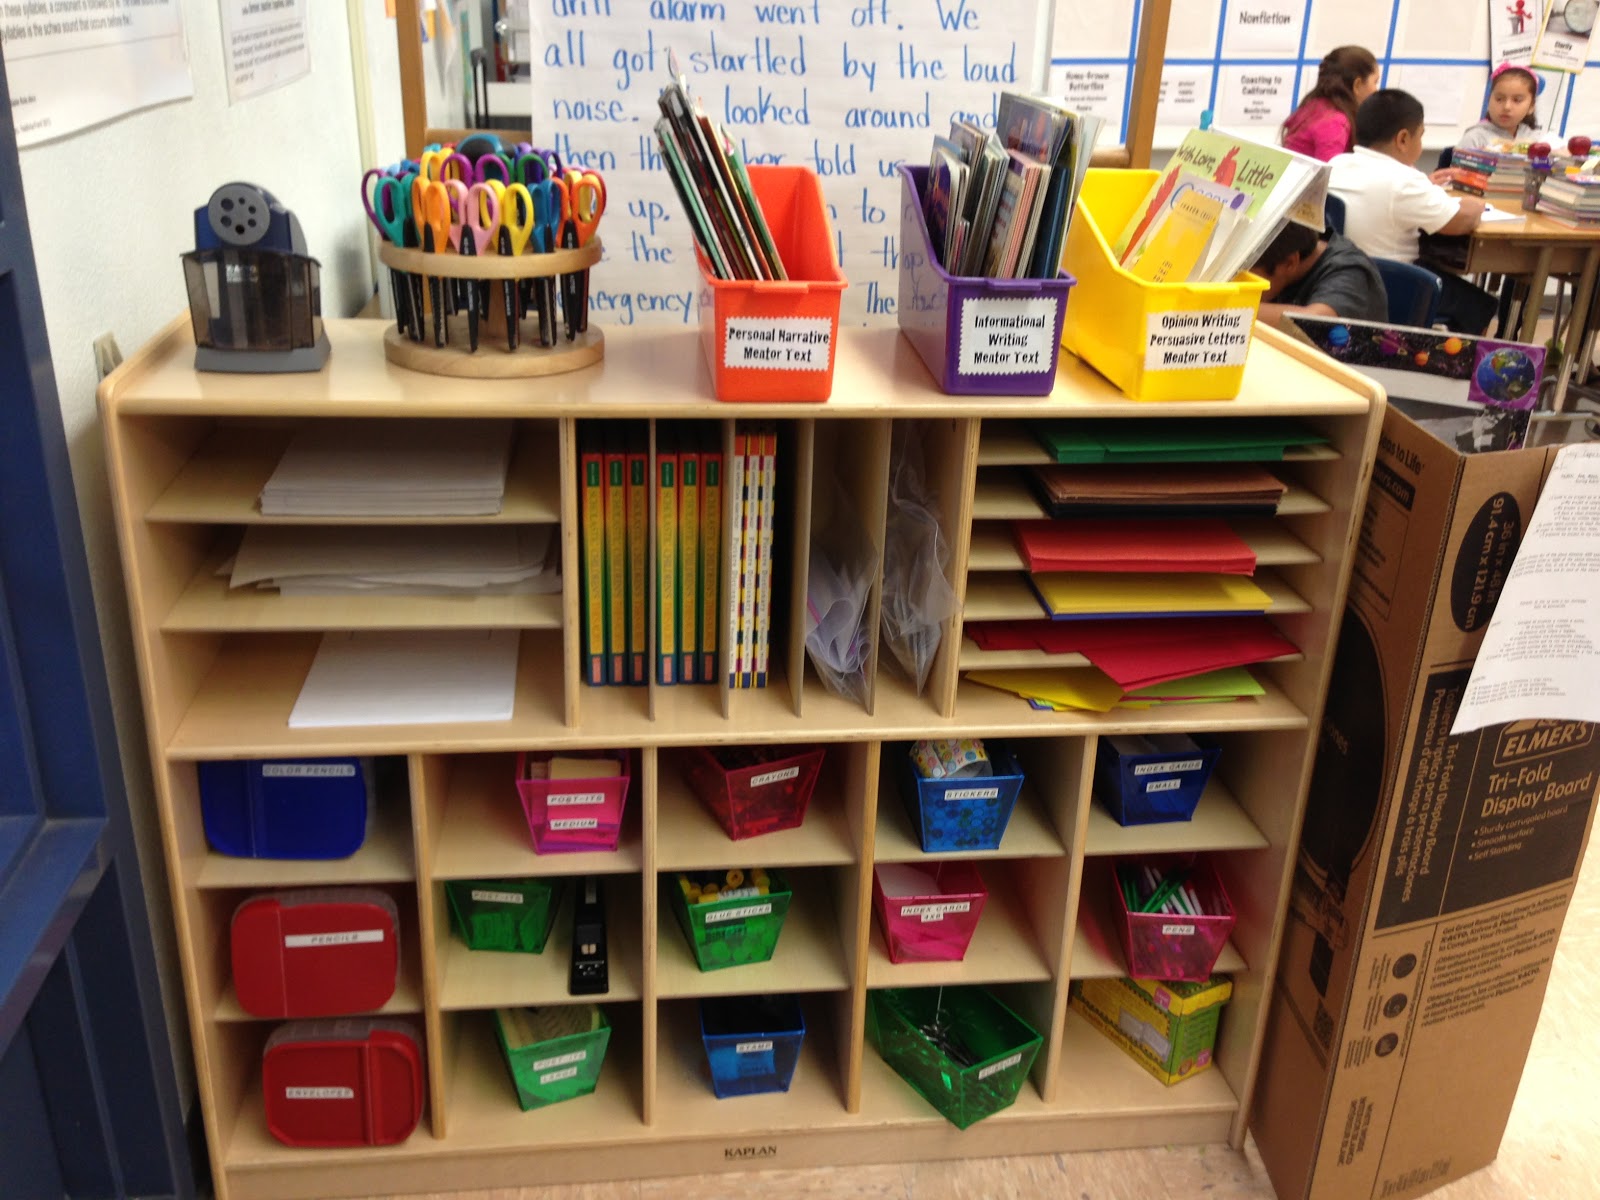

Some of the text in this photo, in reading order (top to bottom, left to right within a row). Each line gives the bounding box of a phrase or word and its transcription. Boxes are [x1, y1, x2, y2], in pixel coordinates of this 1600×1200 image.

[650, 0, 725, 22] alarm
[755, 0, 820, 24] went
[936, 0, 980, 31] We
[1239, 11, 1291, 24] Nonfiction
[544, 29, 1017, 92] all got startled by the loud
[1242, 86, 1278, 95] California
[1274, 76, 1282, 85] to
[553, 97, 639, 122] noise.
[724, 84, 810, 126] looked
[844, 91, 931, 129] around
[1236, 157, 1275, 190] Little
[627, 187, 886, 236] up. to
[625, 230, 677, 265] the
[588, 290, 693, 326] ergency
[974, 315, 1046, 328] Informational
[1162, 313, 1242, 330] Opinion Writing
[728, 327, 829, 344] Personal Narrative
[988, 333, 1028, 347] Writing
[1150, 332, 1246, 347] Persuasive Letters
[743, 347, 812, 362] Mentor Text
[974, 351, 1040, 364] Mentor Text
[1163, 350, 1228, 365] Mentor Text
[1488, 497, 1505, 529] 91.4
[1483, 531, 1495, 554] cm
[1480, 556, 1489, 566] x
[1465, 607, 1477, 629] cm
[1423, 687, 1447, 745] Panneau
[1502, 722, 1588, 758] ELMER'S
[752, 768, 796, 785] CRAYONS
[1408, 746, 1434, 816] d'affichage
[1488, 761, 1553, 794] Tri-Fold
[1420, 782, 1435, 811] para
[1481, 771, 1592, 819] Display Board
[1419, 742, 1460, 876] Tri-Fold Display Board
[553, 820, 596, 829] MEDIUM
[1399, 825, 1416, 854] trois
[1395, 854, 1408, 877] plis
[1401, 812, 1431, 904] presentaciones
[725, 1145, 777, 1157] KAPLAN
